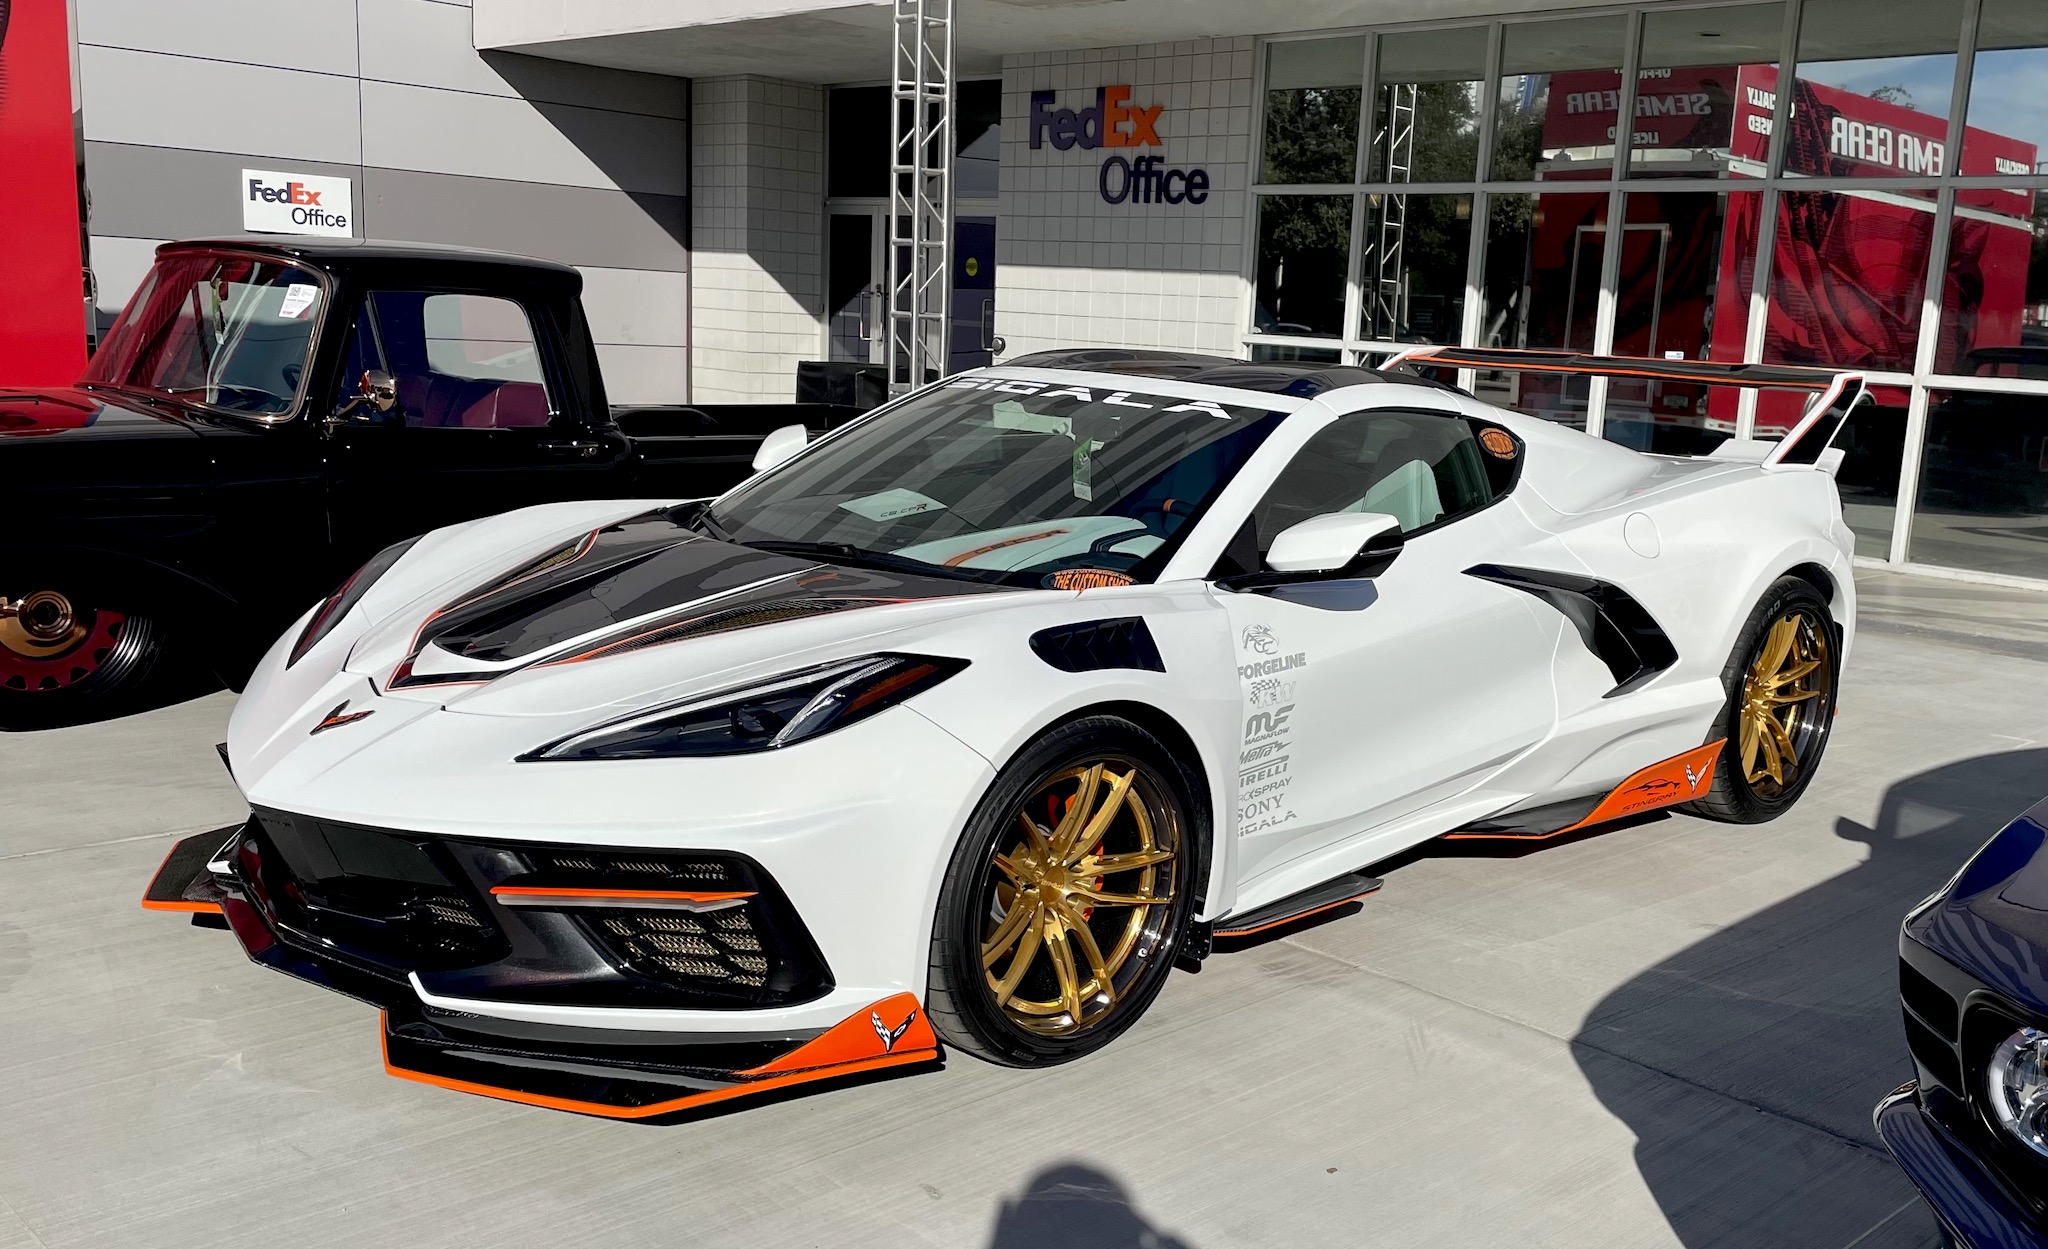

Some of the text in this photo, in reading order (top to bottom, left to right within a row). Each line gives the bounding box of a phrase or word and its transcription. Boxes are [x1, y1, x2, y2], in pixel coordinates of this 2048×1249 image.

[1029, 85, 1164, 150] FedEx
[249, 178, 322, 206] FedEx
[1100, 155, 1210, 204] Office
[291, 207, 347, 227] Office
[949, 376, 1232, 420] SIGALA
[1054, 574, 1072, 590] THE
[1070, 573, 1109, 592] CUSTOM
[1237, 652, 1307, 680] FORGELINE
[1245, 726, 1290, 746] MAGNAFLOW
[1620, 791, 1681, 813] STINGRAY
